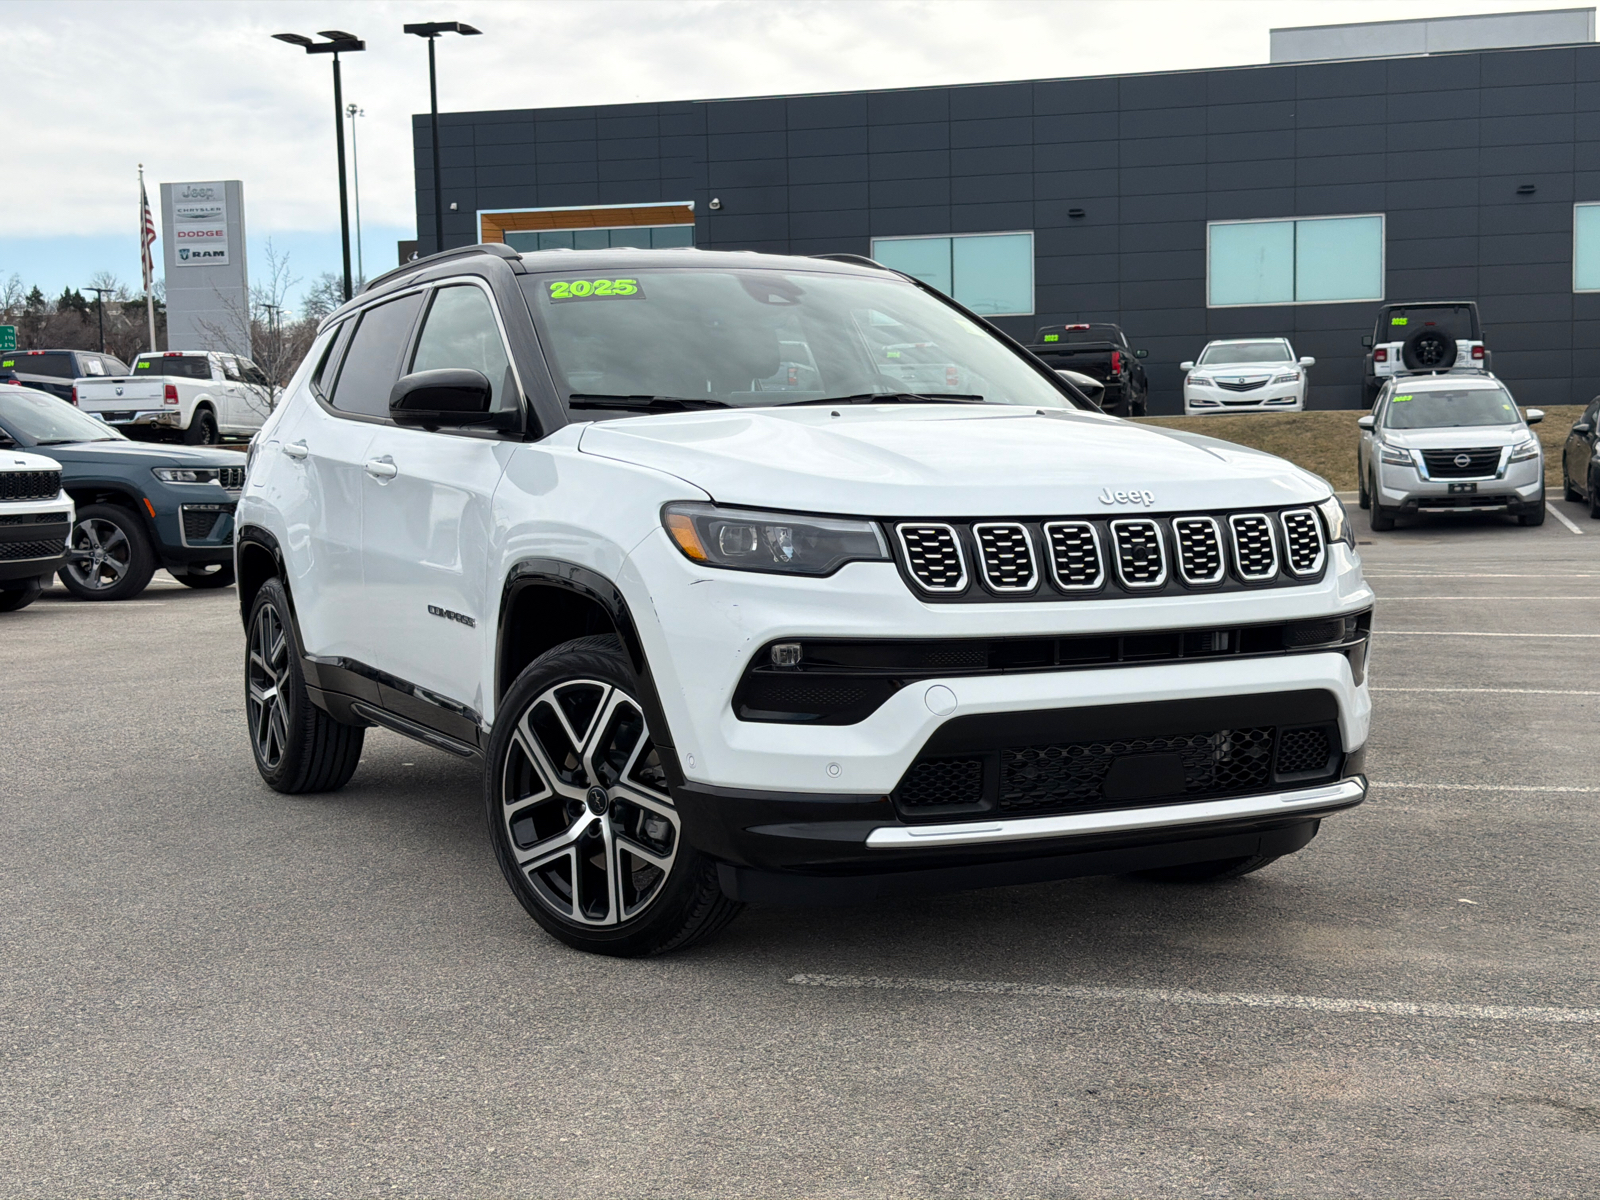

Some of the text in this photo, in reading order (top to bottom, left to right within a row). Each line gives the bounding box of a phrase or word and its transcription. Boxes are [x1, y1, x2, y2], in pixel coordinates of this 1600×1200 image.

[182, 186, 214, 199] Jeep
[177, 230, 224, 238] DODGE
[549, 279, 638, 299] 2025
[1098, 486, 1155, 508] Jeep
[427, 604, 476, 629] COMPASS
